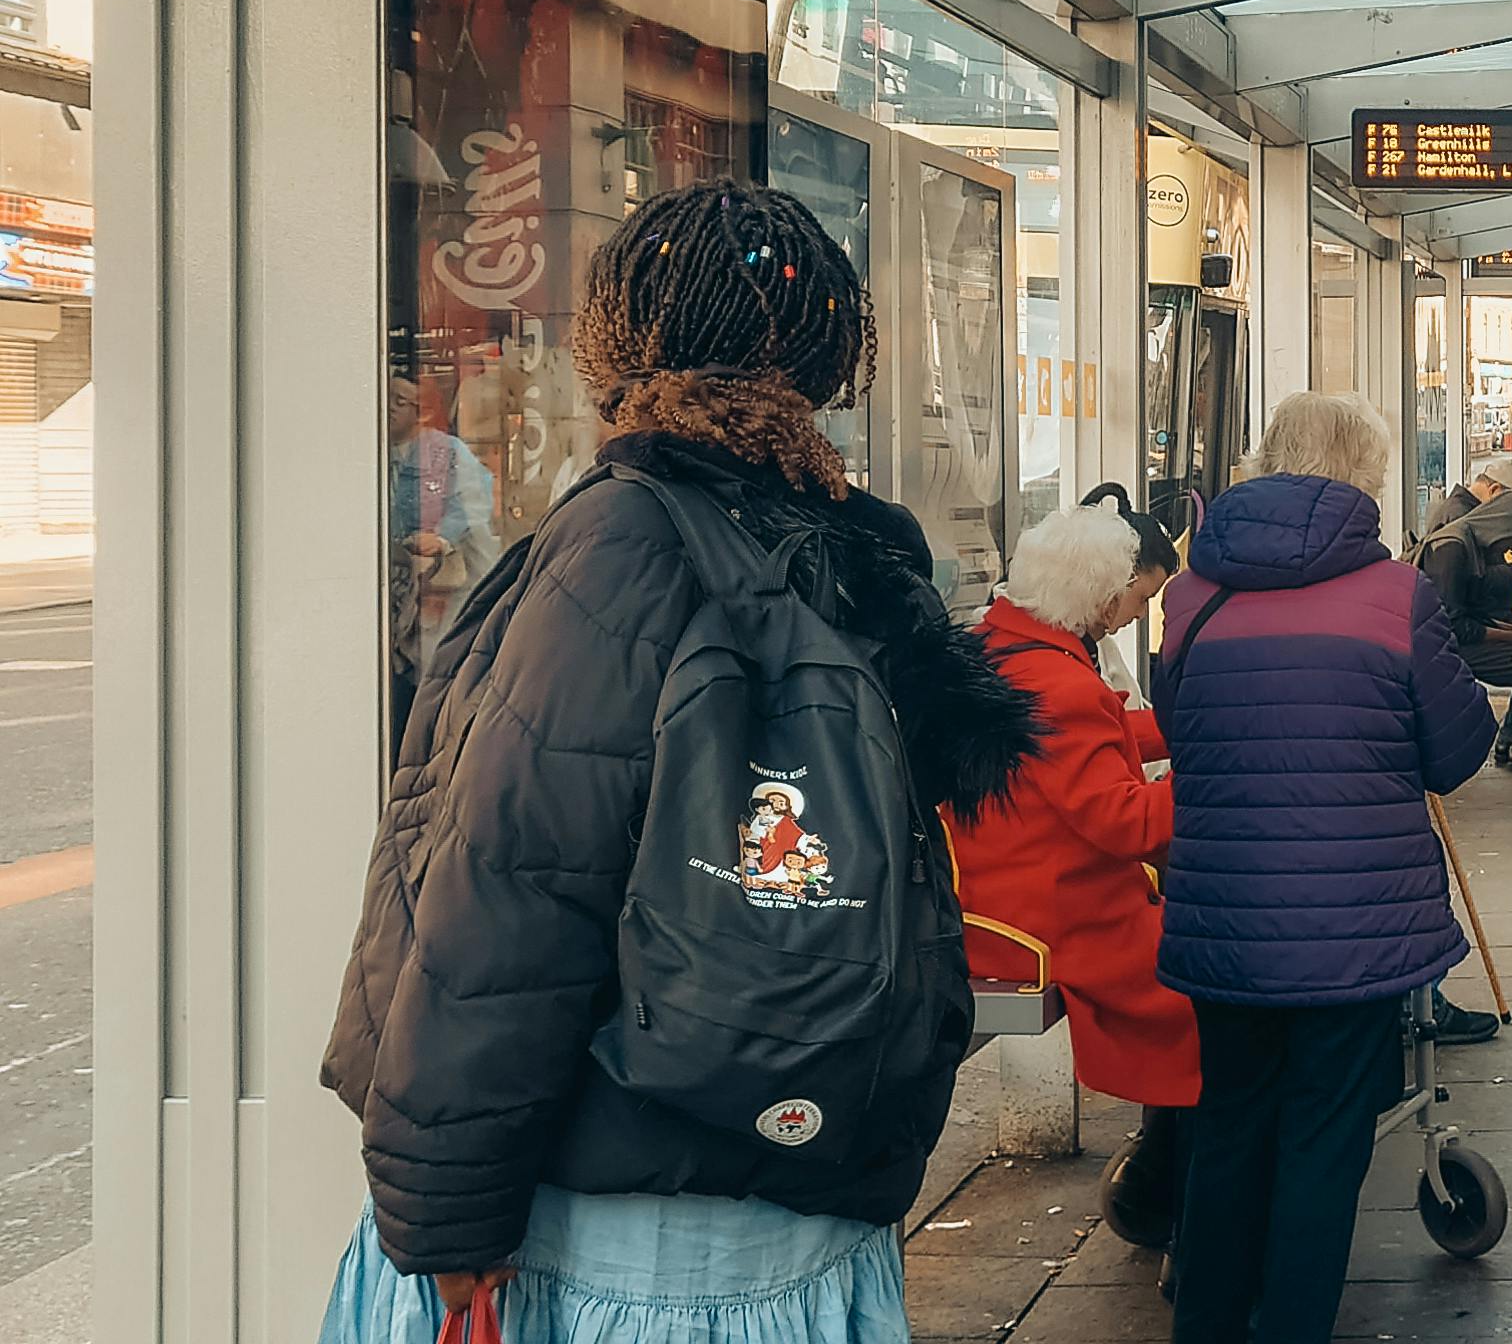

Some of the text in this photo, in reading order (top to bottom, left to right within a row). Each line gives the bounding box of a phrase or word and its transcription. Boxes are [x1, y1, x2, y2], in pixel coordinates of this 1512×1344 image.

[1417, 124, 1491, 136] Castlemilk
[1417, 138, 1490, 150] Greenhills
[1382, 151, 1405, 162] 267
[1417, 151, 1476, 162] Hamilton
[1382, 164, 1397, 175] 21
[1149, 189, 1184, 203] zero
[749, 760, 788, 780] WINNERS
